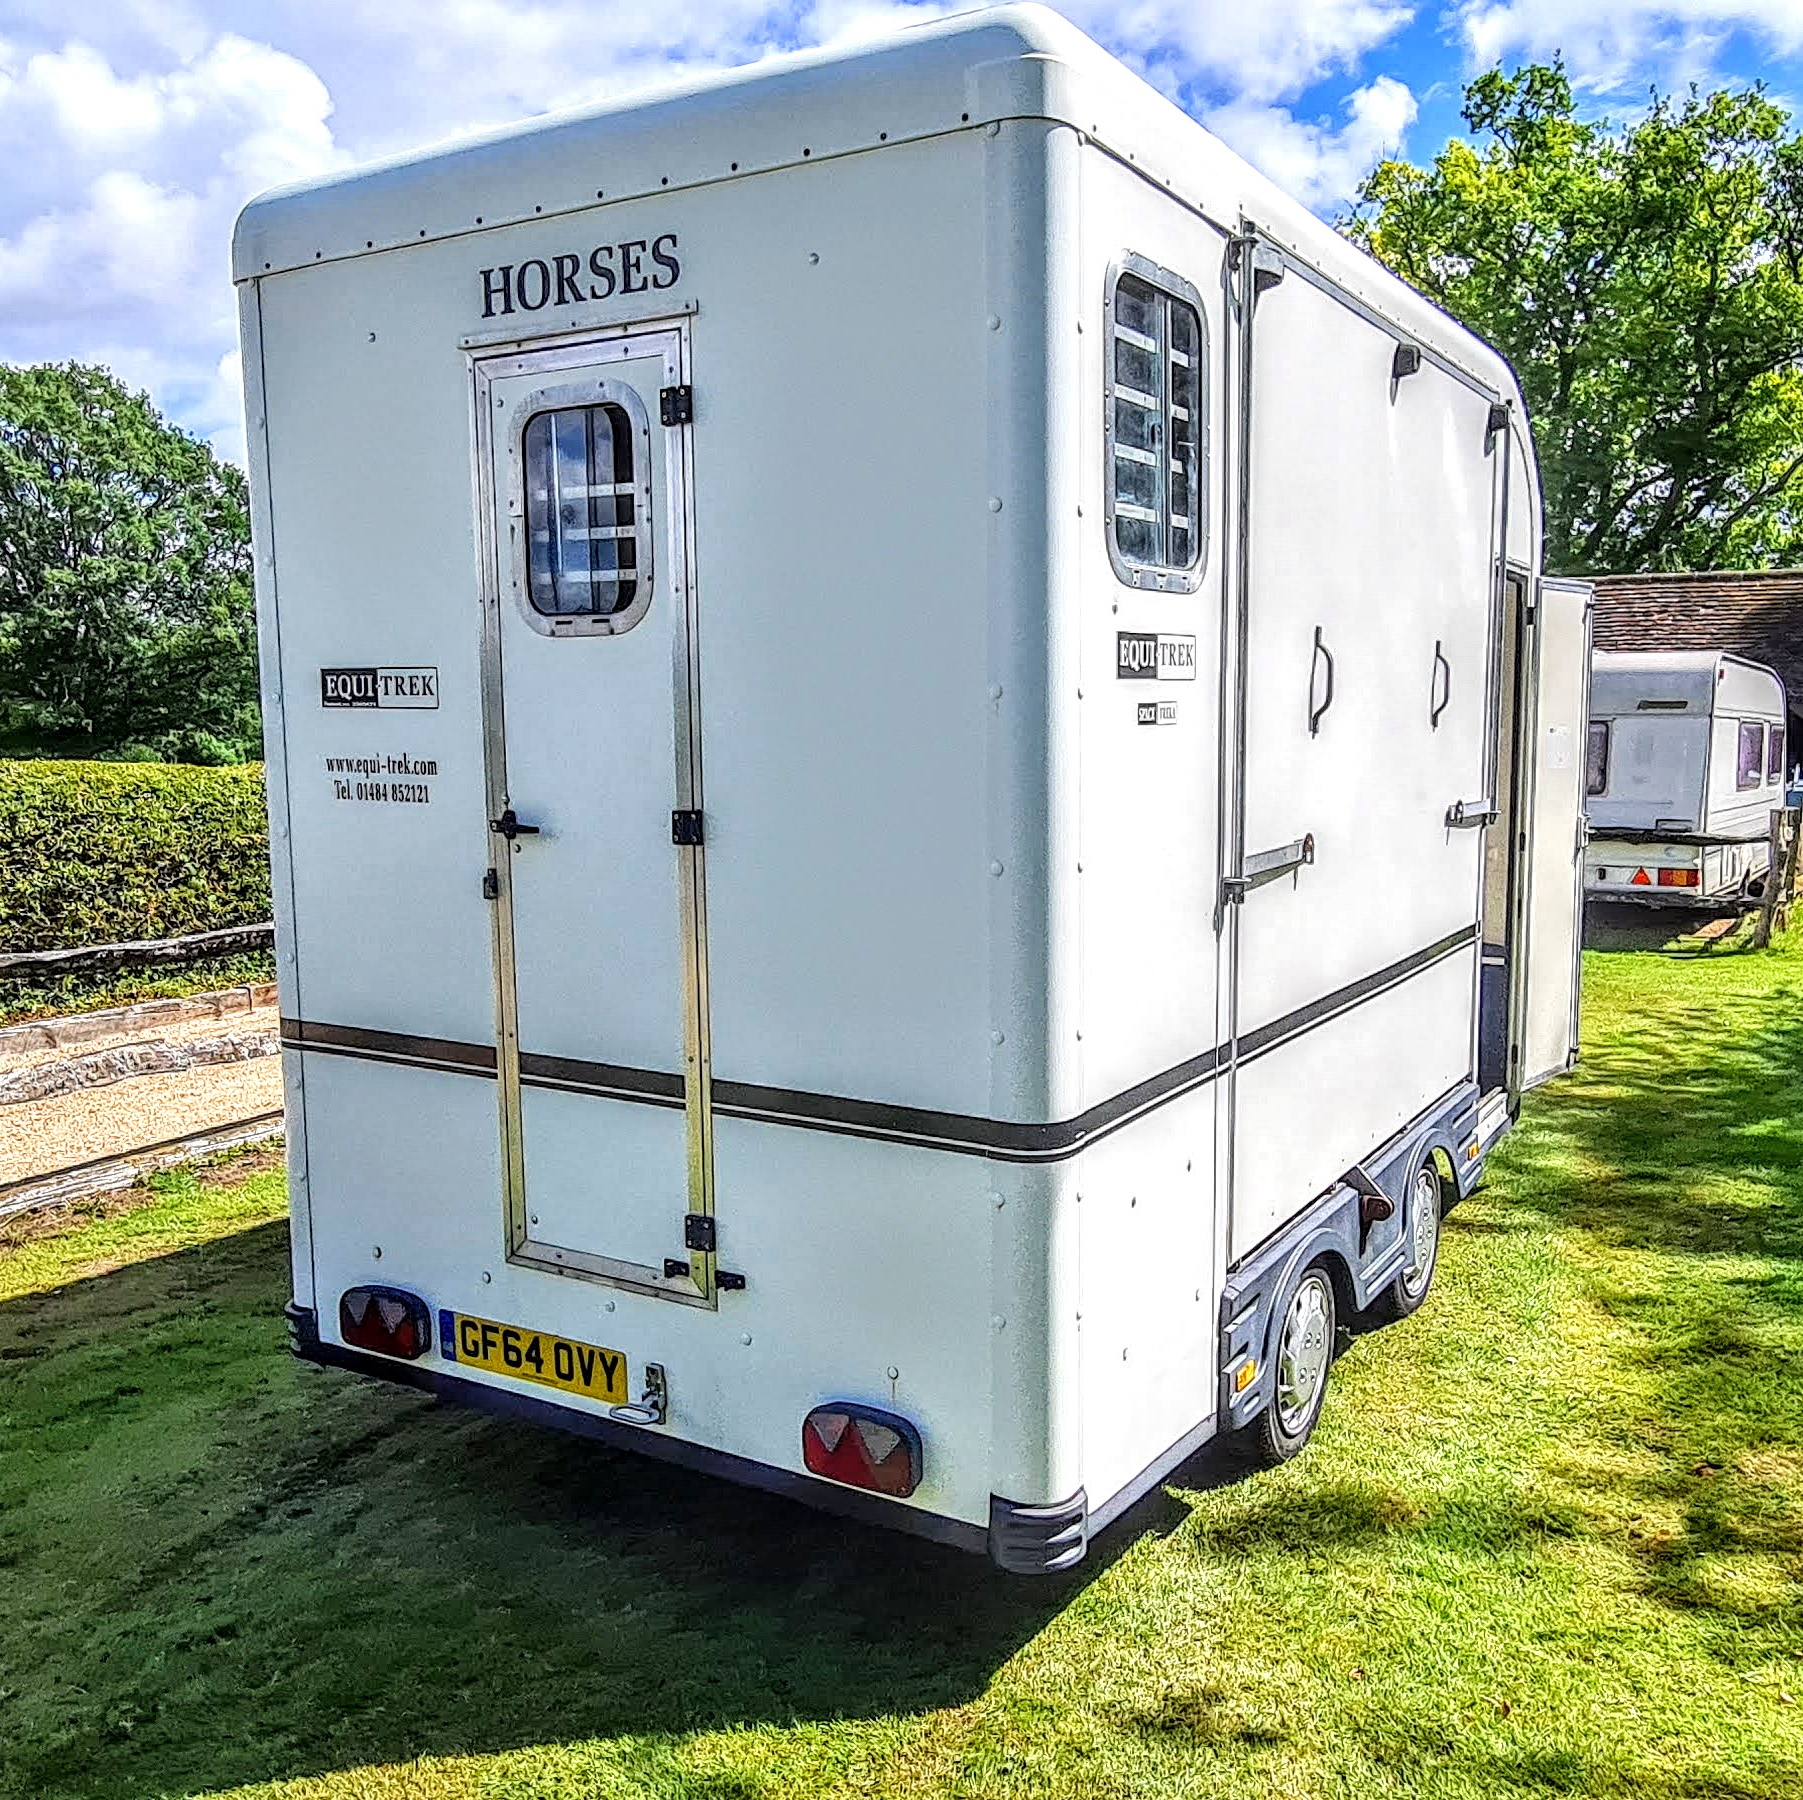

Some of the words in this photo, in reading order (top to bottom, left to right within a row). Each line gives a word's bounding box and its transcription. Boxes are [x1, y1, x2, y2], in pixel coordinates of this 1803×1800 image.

[479, 234, 680, 318] HORSES
[326, 752, 438, 779] www.equi-trek.com
[334, 778, 353, 801] Tel.
[357, 782, 388, 802] 01484
[391, 784, 430, 804] 852121
[460, 1319, 544, 1374] GF64
[554, 1341, 619, 1394] OVY
